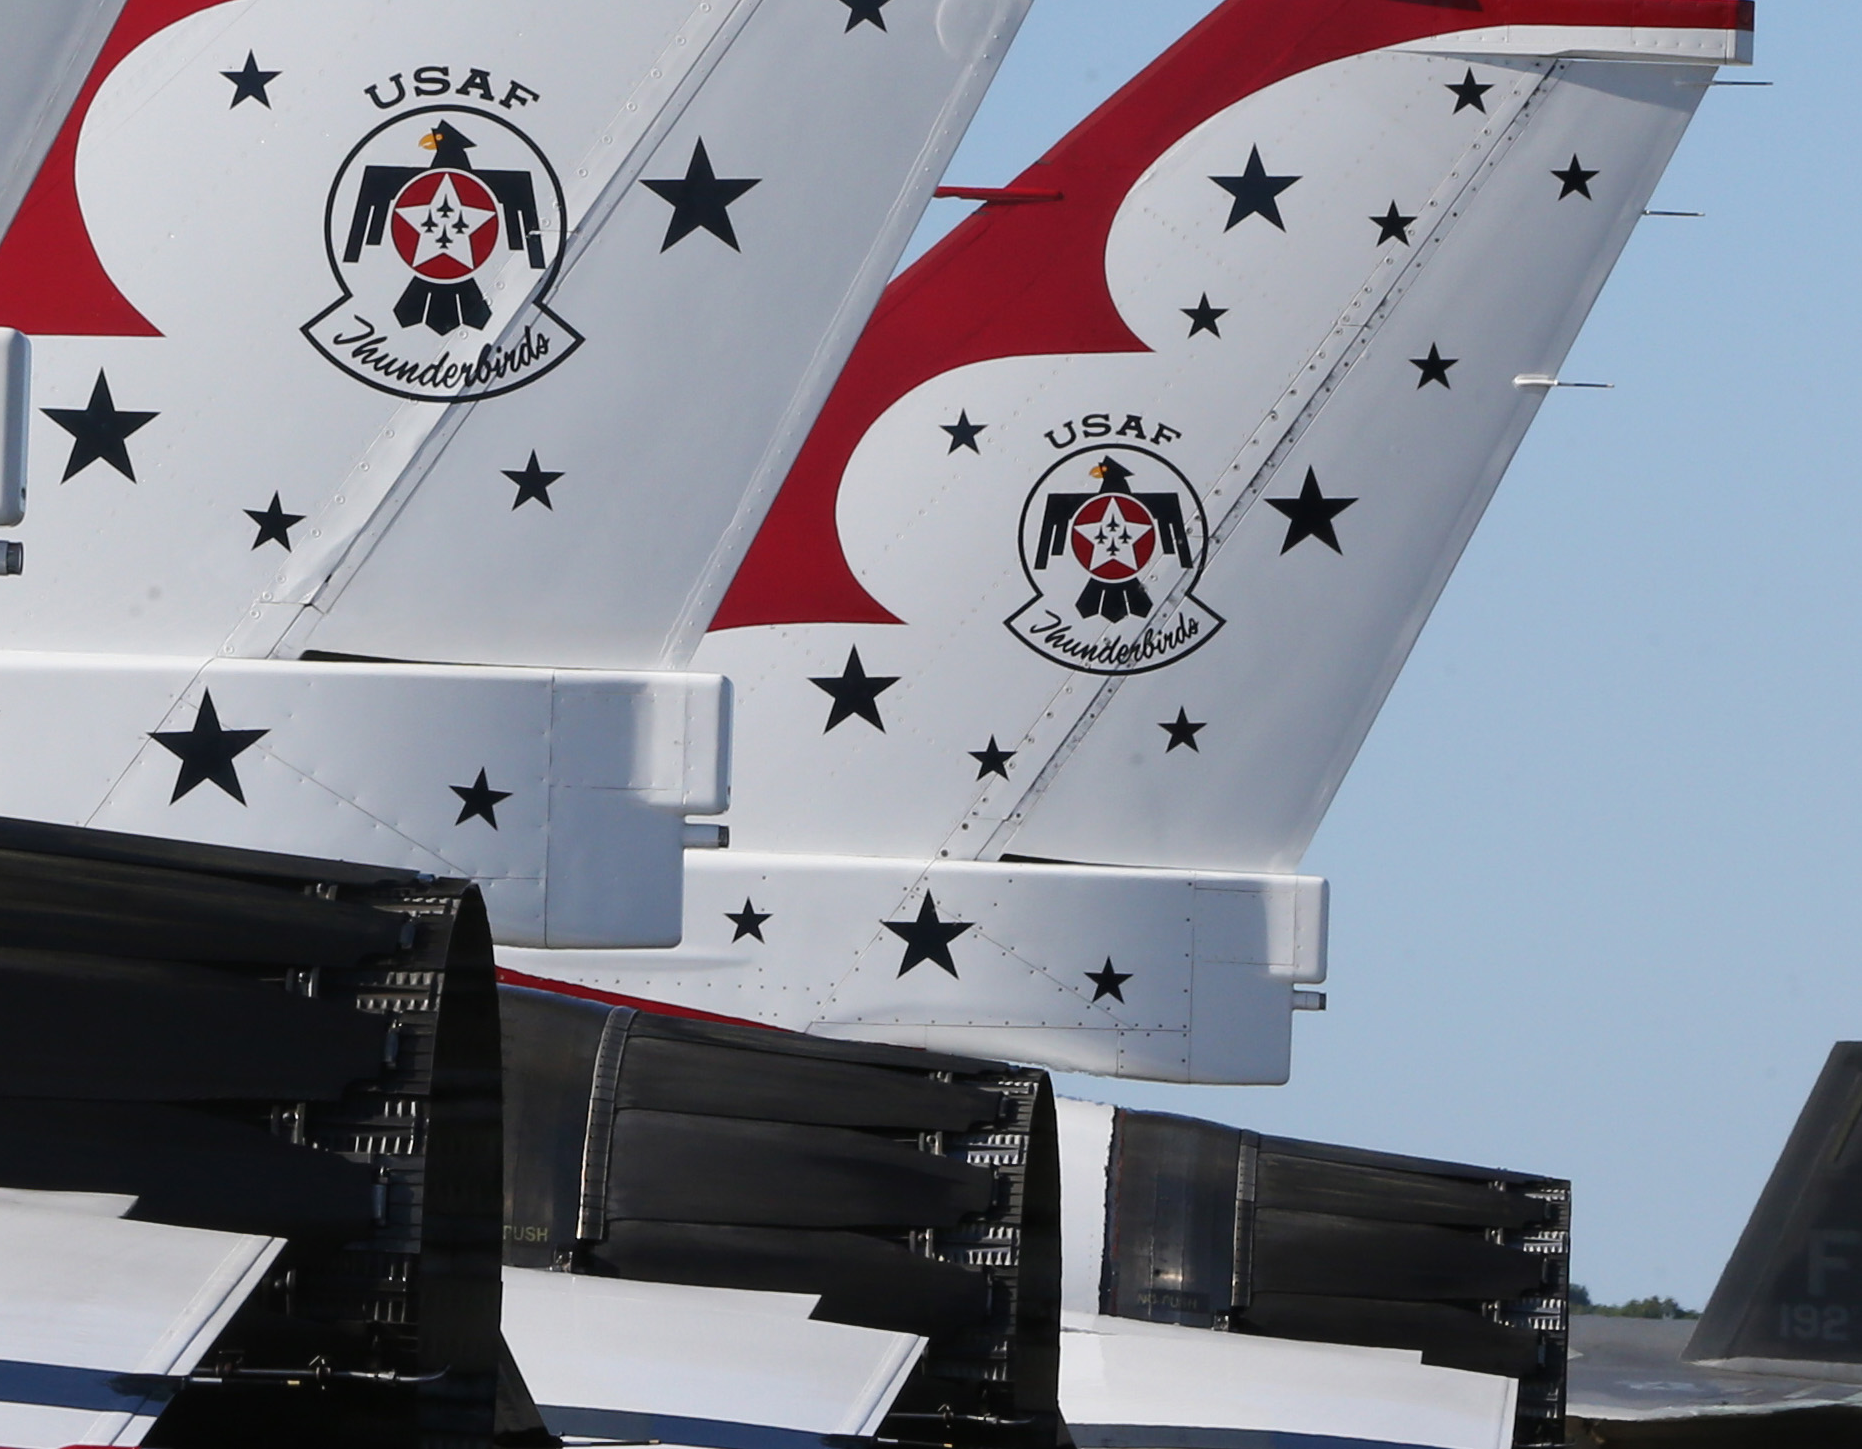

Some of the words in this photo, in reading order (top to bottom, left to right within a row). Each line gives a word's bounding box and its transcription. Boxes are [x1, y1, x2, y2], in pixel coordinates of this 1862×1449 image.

[364, 66, 541, 110] USAF
[332, 313, 551, 389] Thunderbirds
[1043, 413, 1182, 449] USAF
[1029, 608, 1200, 665] Thunderbirds
